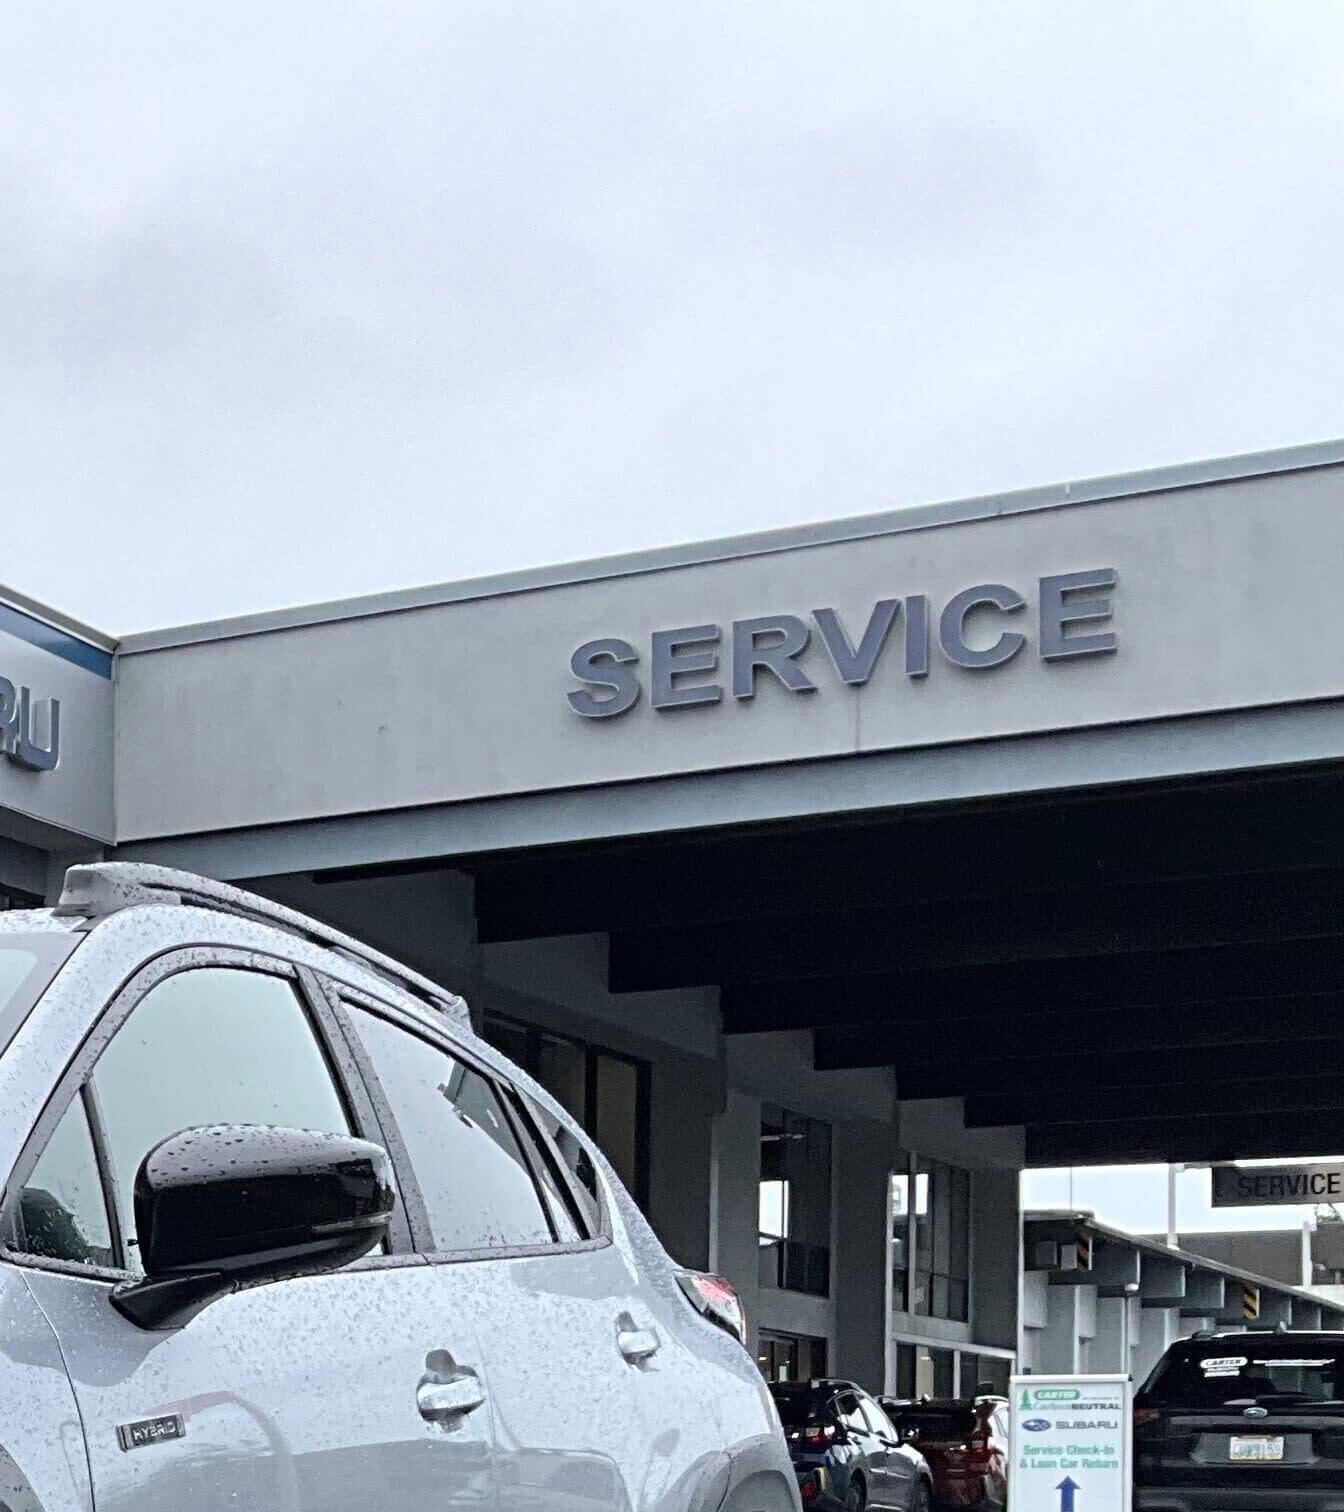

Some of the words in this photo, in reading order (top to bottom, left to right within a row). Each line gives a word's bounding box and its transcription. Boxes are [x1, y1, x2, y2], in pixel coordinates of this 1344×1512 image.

[567, 567, 1118, 719] SERVICE
[1237, 1172, 1342, 1198] SERVICE
[1055, 1421, 1118, 1429] SUBARU
[1023, 1445, 1063, 1455] Service
[1032, 1458, 1057, 1468] Loan
[1060, 1458, 1079, 1468] Car
[1082, 1458, 1118, 1468] Return
